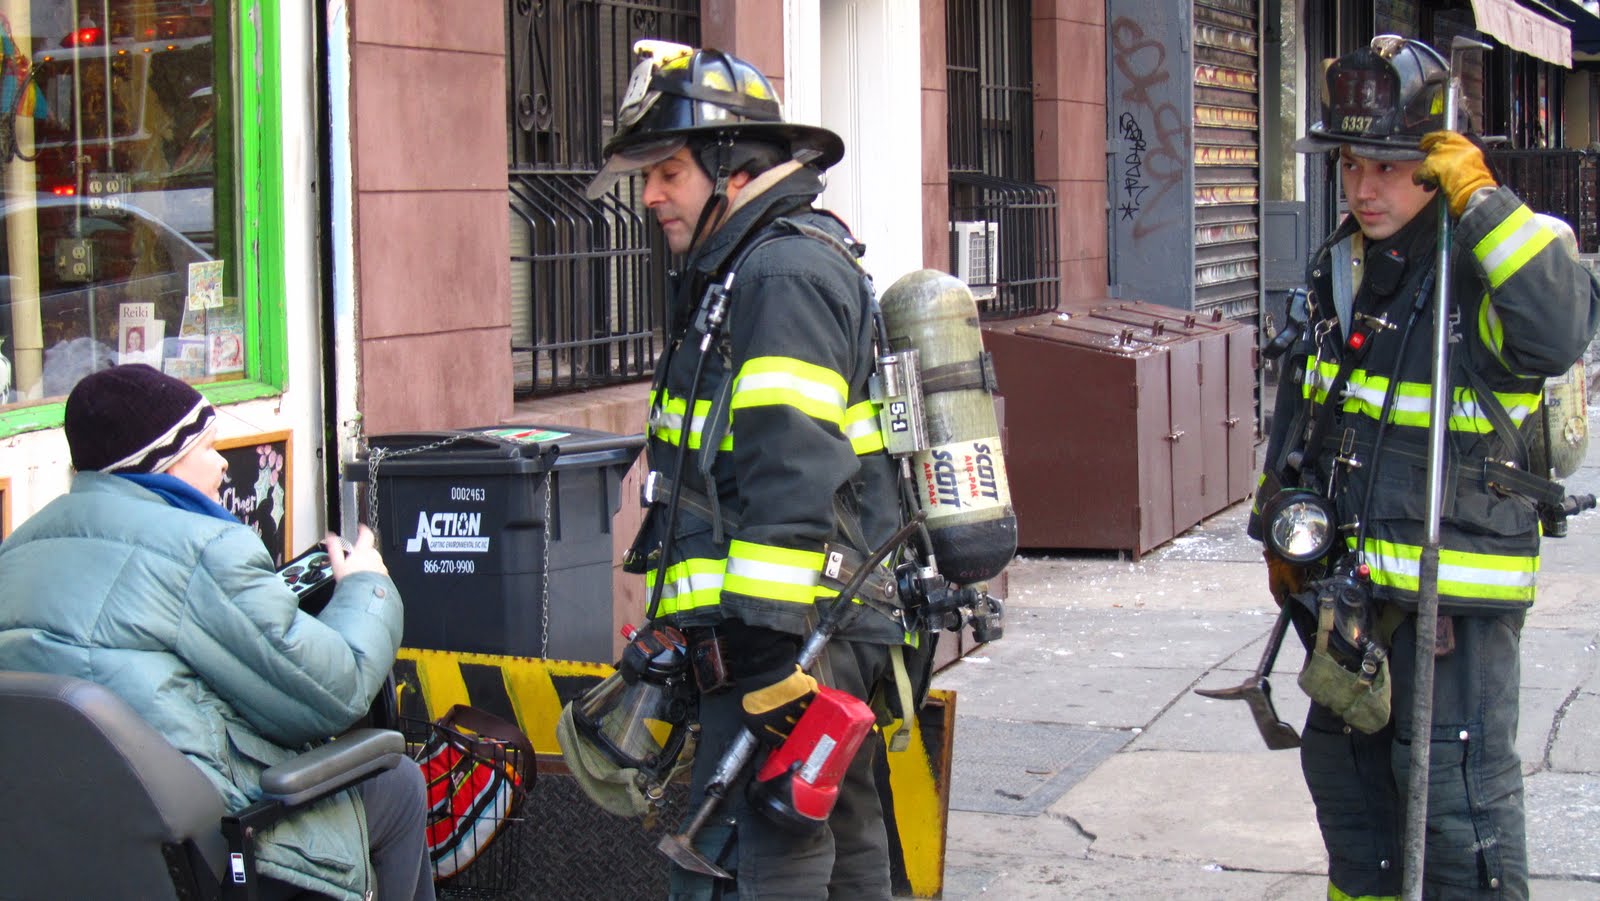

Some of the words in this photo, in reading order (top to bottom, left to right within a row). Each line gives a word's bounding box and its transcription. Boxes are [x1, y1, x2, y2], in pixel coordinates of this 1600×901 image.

[1341, 115, 1373, 132] 6337
[123, 306, 149, 318] Reiki
[923, 461, 938, 506] AIR-PAK
[931, 449, 961, 509] SCOTT
[964, 454, 979, 498] AIR-PAK
[973, 442, 999, 501] SCOTT
[451, 487, 486, 501] 0002463
[412, 511, 482, 542] ACTION
[423, 559, 475, 574] 866-270-9900
